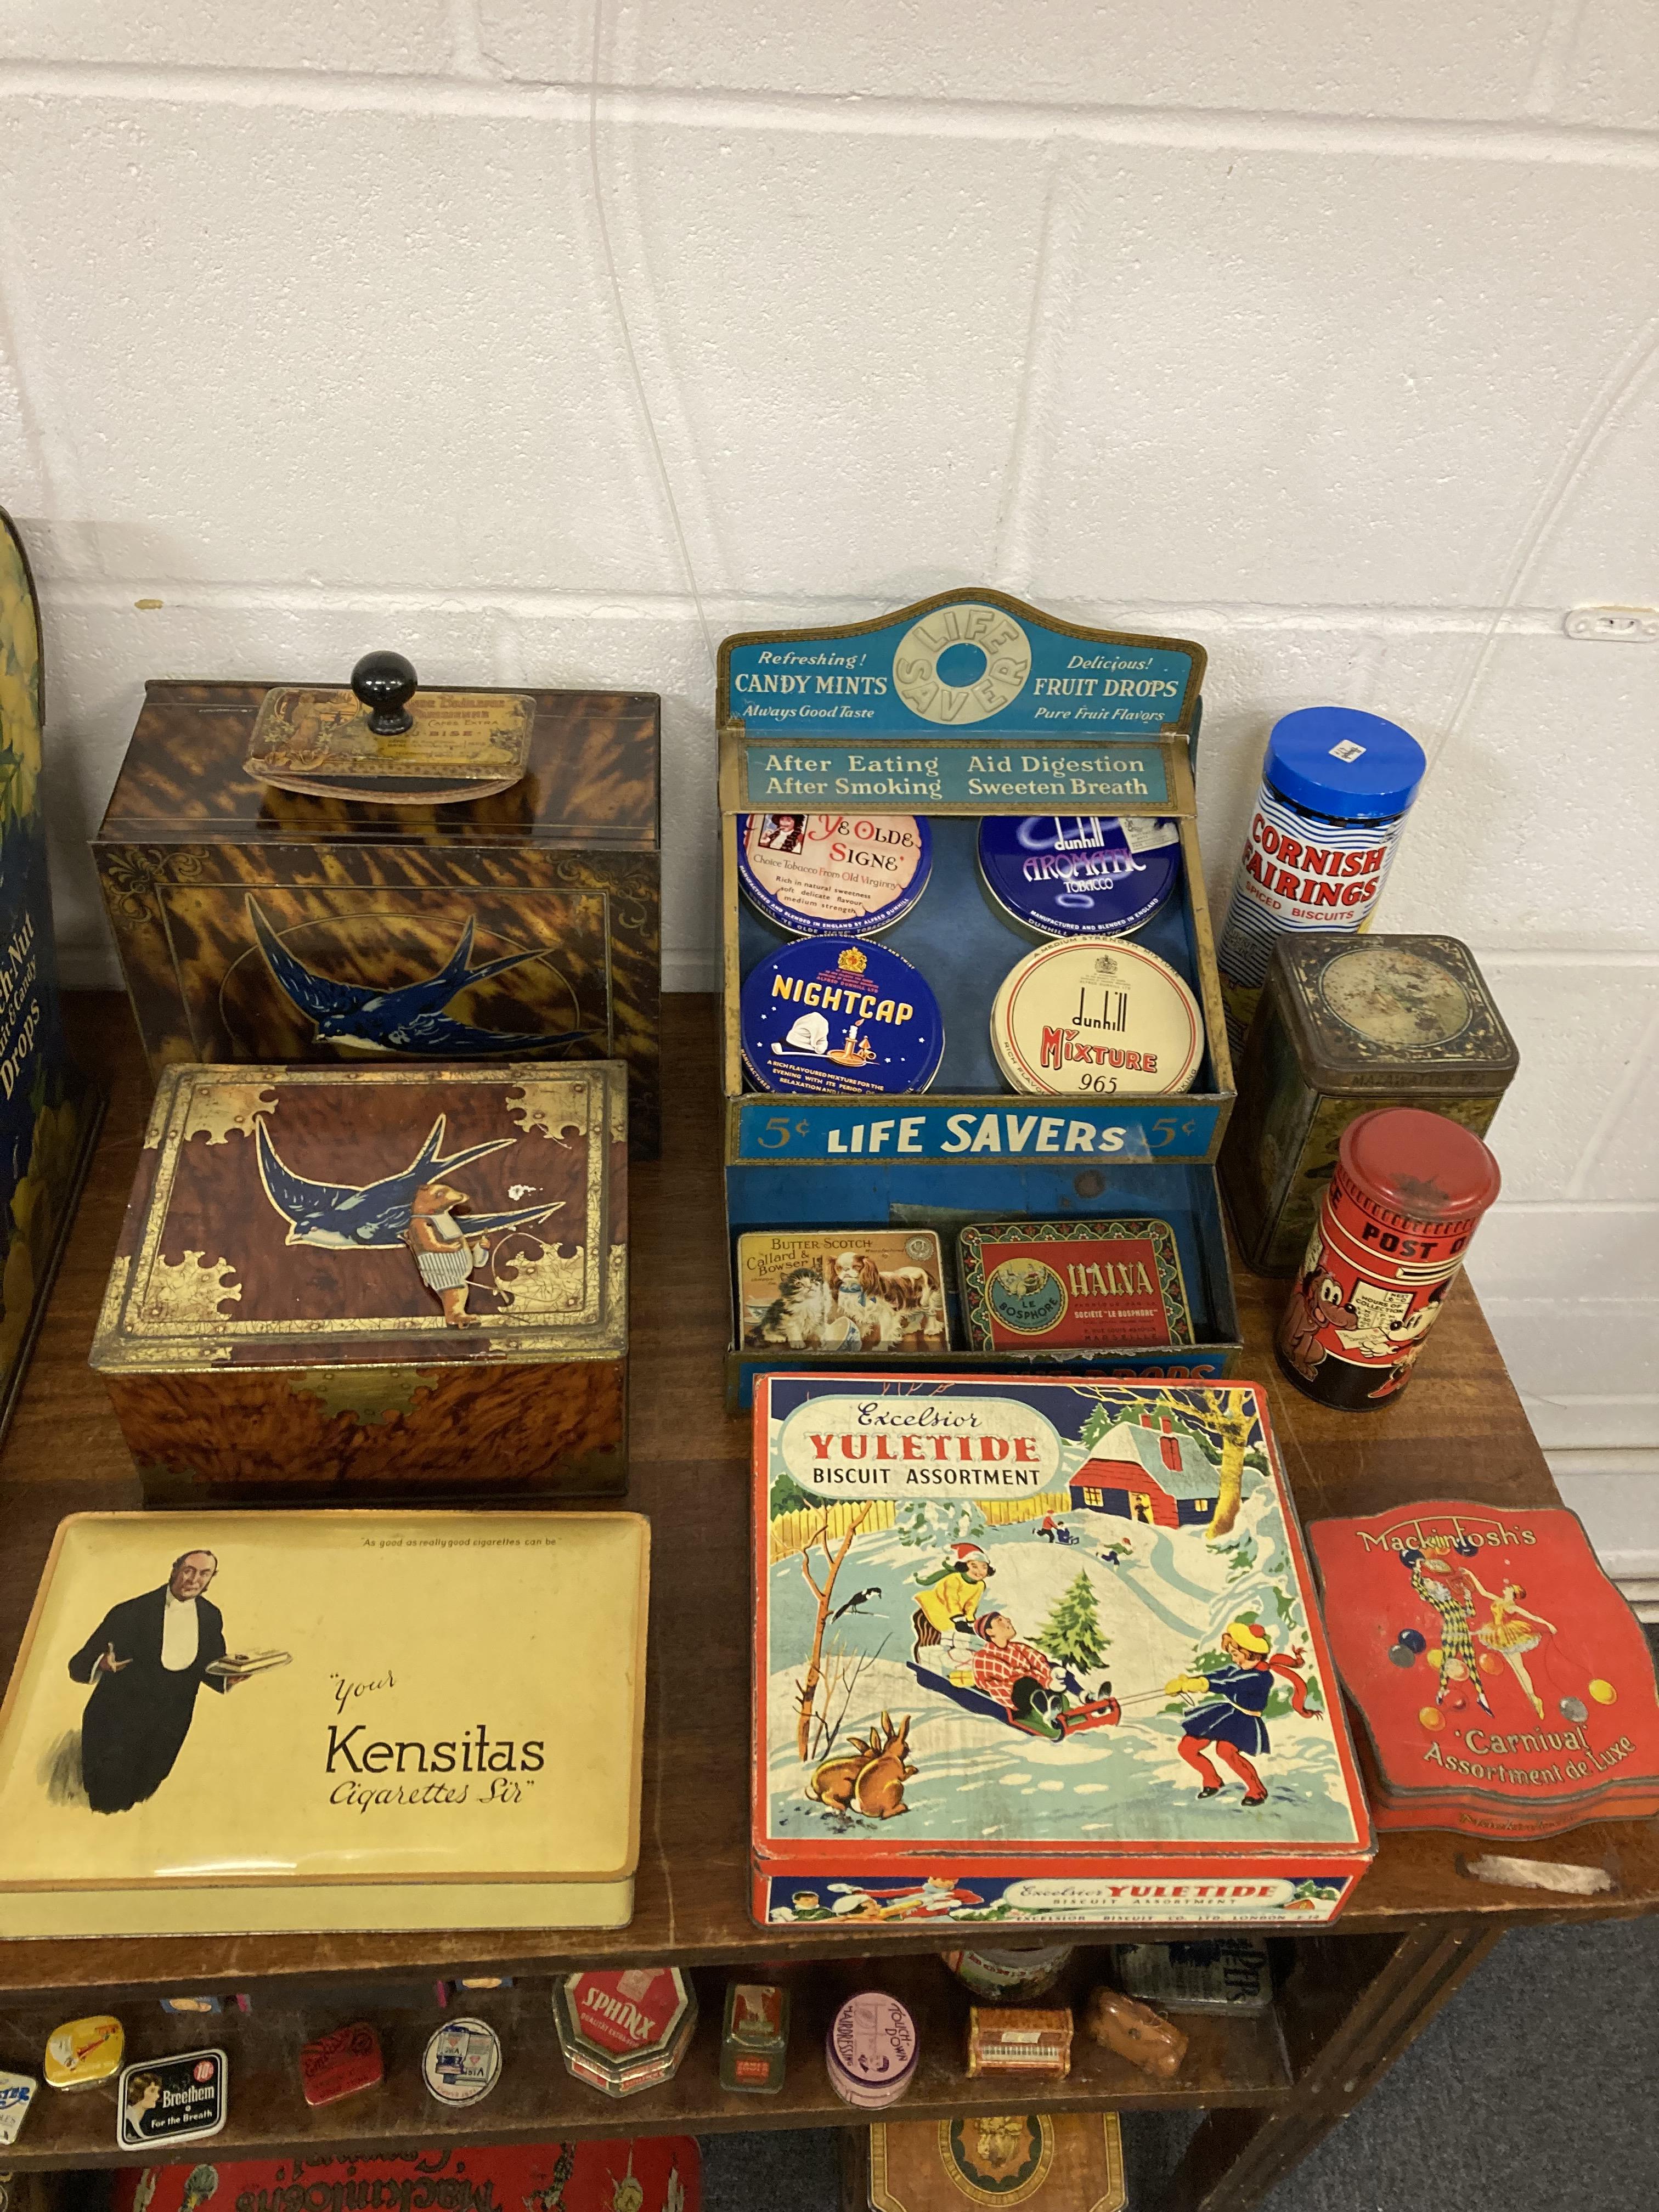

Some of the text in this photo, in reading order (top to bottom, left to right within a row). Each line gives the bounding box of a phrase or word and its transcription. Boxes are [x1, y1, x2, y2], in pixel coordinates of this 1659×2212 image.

[914, 609, 1019, 655] LIFE
[758, 651, 866, 668] Refreshing!
[1067, 656, 1153, 672] Delicious!
[735, 674, 888, 696] CANDY MINTS
[899, 658, 1028, 721] SAVER
[1034, 678, 1179, 698] FRUIT DROPS
[743, 704, 874, 721] Always Good Taste
[1035, 705, 1165, 723] Pure Fruit Flavors
[765, 755, 939, 776] After Eating
[967, 756, 1144, 777] Aid Digestion
[765, 778, 943, 800] After Smoking
[968, 779, 1148, 796] Sweeten Breath
[1054, 816, 1105, 850] dunhill
[1252, 812, 1388, 878] CORNISH
[753, 854, 782, 867] Choice
[783, 859, 818, 874] Tobacco
[819, 867, 840, 879] From
[842, 872, 859, 882] Old
[1023, 848, 1147, 882] AROMATIC
[1242, 838, 1379, 907] FAIRINGS
[776, 876, 792, 885] Rich
[804, 881, 831, 892] natural
[834, 888, 871, 900] sweetness
[780, 885, 863, 906] soft delicate flavour
[1063, 878, 1114, 894] TOBACCO
[770, 903, 783, 913] AND
[784, 911, 811, 925] BLENDED
[864, 913, 885, 926] ALFRED
[885, 898, 910, 916] DUNHILL
[783, 895, 856, 914] medium strength
[1246, 879, 1355, 922] SPICED BISCUITS
[1030, 910, 1080, 930] MANUFACTURED
[1098, 919, 1127, 930] BLENDED
[1135, 898, 1159, 918] ENGLAND
[1027, 917, 1069, 937] DUNHILL
[1041, 937, 1077, 953] MEDIUM
[1082, 935, 1139, 950] STRENGTH
[1143, 947, 1180, 978] MIXTURE
[771, 973, 914, 1026] NIGHTCAP
[1072, 987, 1128, 1032] dunhill
[0, 998, 40, 1101] Drops
[1004, 1042, 1017, 1064] RICH
[1041, 1026, 1158, 1073] MIXTURE
[772, 1061, 788, 1070] RICH
[788, 1063, 827, 1078] FLAVOURED
[827, 1073, 858, 1085] MIXTURE
[857, 1080, 871, 1088] FOR
[870, 1083, 884, 1092] THE
[772, 1068, 802, 1080] EVENING
[804, 1075, 823, 1085] WITH
[838, 1084, 862, 1093] PERIOD
[779, 1077, 821, 1092] RELAXATION
[1078, 1073, 1118, 1094] 965
[757, 1118, 809, 1149] 5¢
[827, 1114, 1127, 1153] LIFE SAVERS
[1362, 1222, 1439, 1260] POST
[747, 1249, 795, 1271] Callard
[801, 1250, 810, 1259] &
[758, 1259, 808, 1277] Bowser
[1066, 1260, 1154, 1297] HALVA
[999, 1297, 1059, 1320] BOSPHORE
[1355, 1299, 1404, 1314] COLLECTION
[1361, 1295, 1389, 1307] HOURS
[857, 1402, 984, 1428] Excelsior
[805, 1430, 1041, 1463] YULETIDE
[812, 1468, 1041, 1486] BISCUIT ASSORTMENT
[379, 1538, 403, 1548] good
[419, 1538, 447, 1548] really
[447, 1538, 470, 1548] good
[473, 1537, 521, 1548] cigarettes
[1357, 1516, 1537, 1553] Mackintosh's
[326, 1725, 544, 1773] Kensitas
[1423, 1735, 1637, 1787] Assortment de Luxe
[329, 1780, 467, 1814] Cigarettes
[1105, 1884, 1277, 1898] YULETIDE
[582, 1987, 656, 2040] SPHINX
[885, 2028, 908, 2062] DOWN
[162, 2085, 215, 2109] Breethem
[151, 2109, 213, 2129] For the Breath
